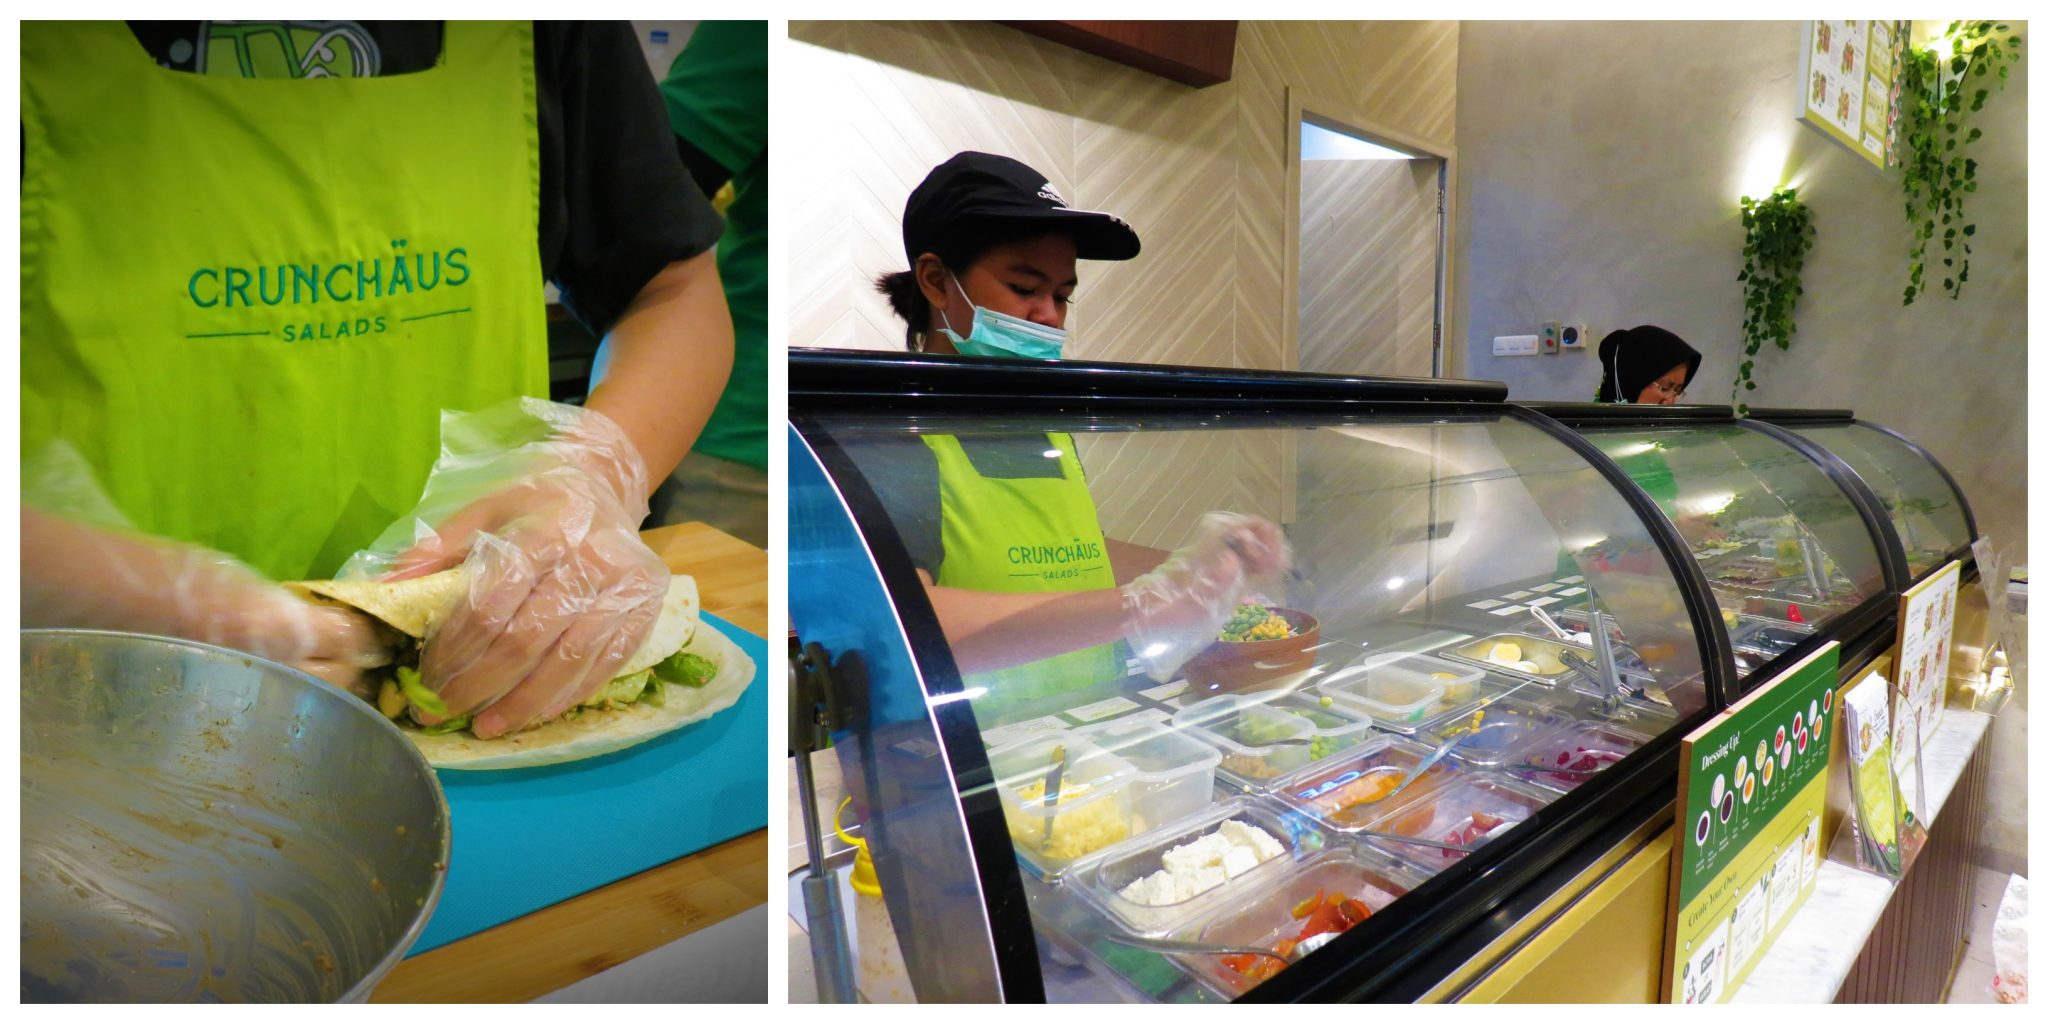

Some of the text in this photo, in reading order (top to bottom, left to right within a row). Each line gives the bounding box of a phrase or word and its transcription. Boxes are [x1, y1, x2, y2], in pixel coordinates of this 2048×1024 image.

[188, 238, 471, 308] CRUNCHÄUS
[282, 316, 387, 343] SALADS
[1007, 538, 1101, 564] CRUNCHÄUS
[1042, 568, 1079, 580] SALADS
[1701, 730, 1740, 771] Dressing Up!
